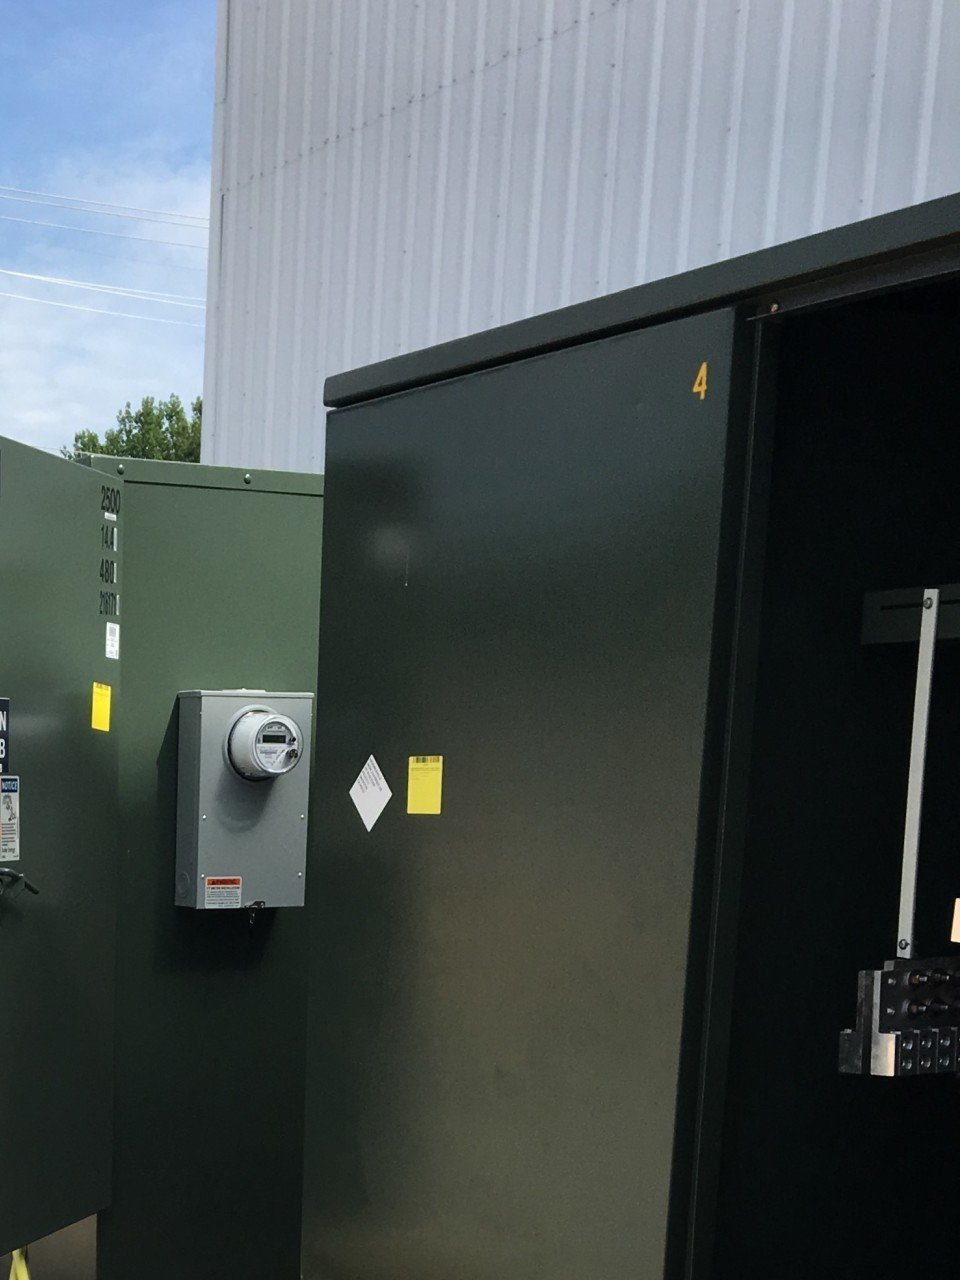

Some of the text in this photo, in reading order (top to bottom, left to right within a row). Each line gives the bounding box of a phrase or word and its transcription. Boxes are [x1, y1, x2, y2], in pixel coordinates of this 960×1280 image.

[692, 361, 708, 400] 4
[101, 485, 121, 514] 2500
[100, 558, 115, 585] 480
[2, 781, 18, 790] NOTICE
